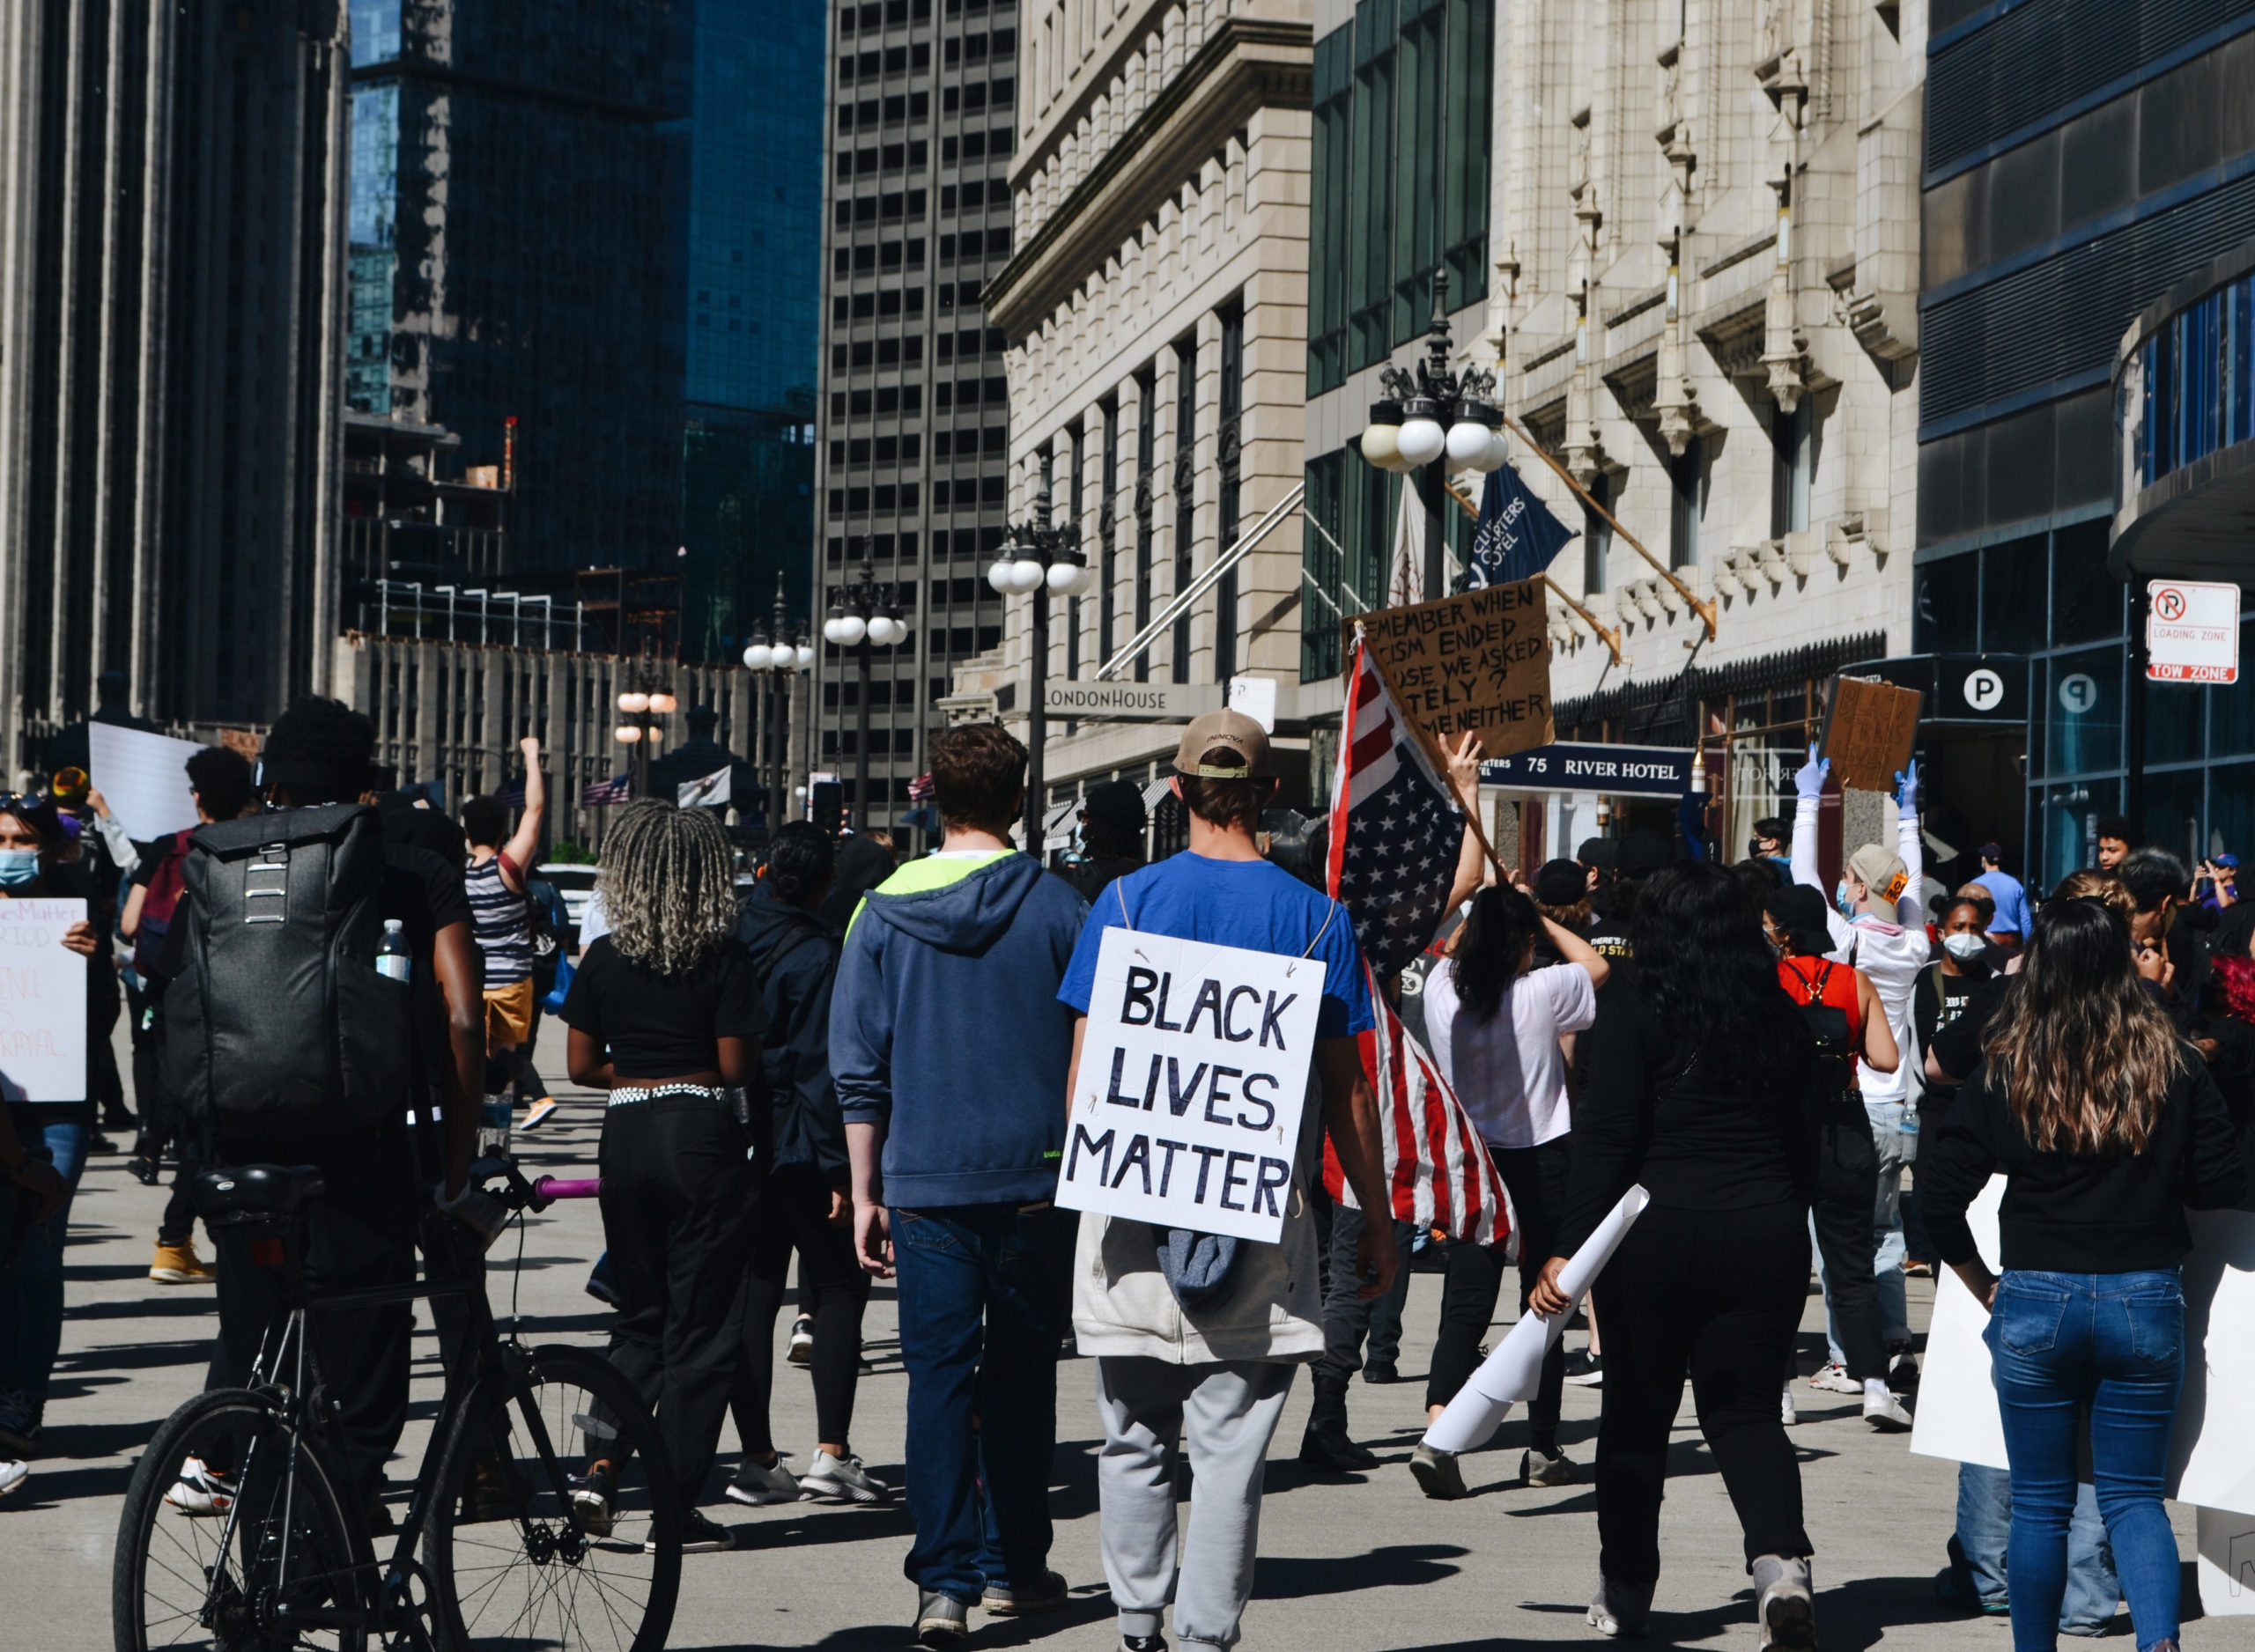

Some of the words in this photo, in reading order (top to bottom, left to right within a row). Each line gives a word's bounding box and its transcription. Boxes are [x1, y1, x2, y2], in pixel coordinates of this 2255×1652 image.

[1471, 584, 1534, 616] WHEN
[1439, 618, 1516, 655] ENDED
[2154, 628, 2195, 639] LOADING
[2201, 631, 2227, 641] ZONE
[1441, 655, 1474, 679] WE
[1479, 637, 1542, 672] ASKED
[2152, 665, 2184, 677] TOW
[2191, 667, 2229, 680] ZONE
[1457, 694, 1544, 732] NEITHER
[1206, 734, 1245, 745] INNOVA
[1527, 757, 1548, 773] 75
[1565, 759, 1617, 777] RIVER
[1622, 763, 1680, 781] HOTEL
[1120, 965, 1298, 1051] BLACK
[1106, 1046, 1280, 1132] LIVES
[1065, 1123, 1290, 1219] MATTER
